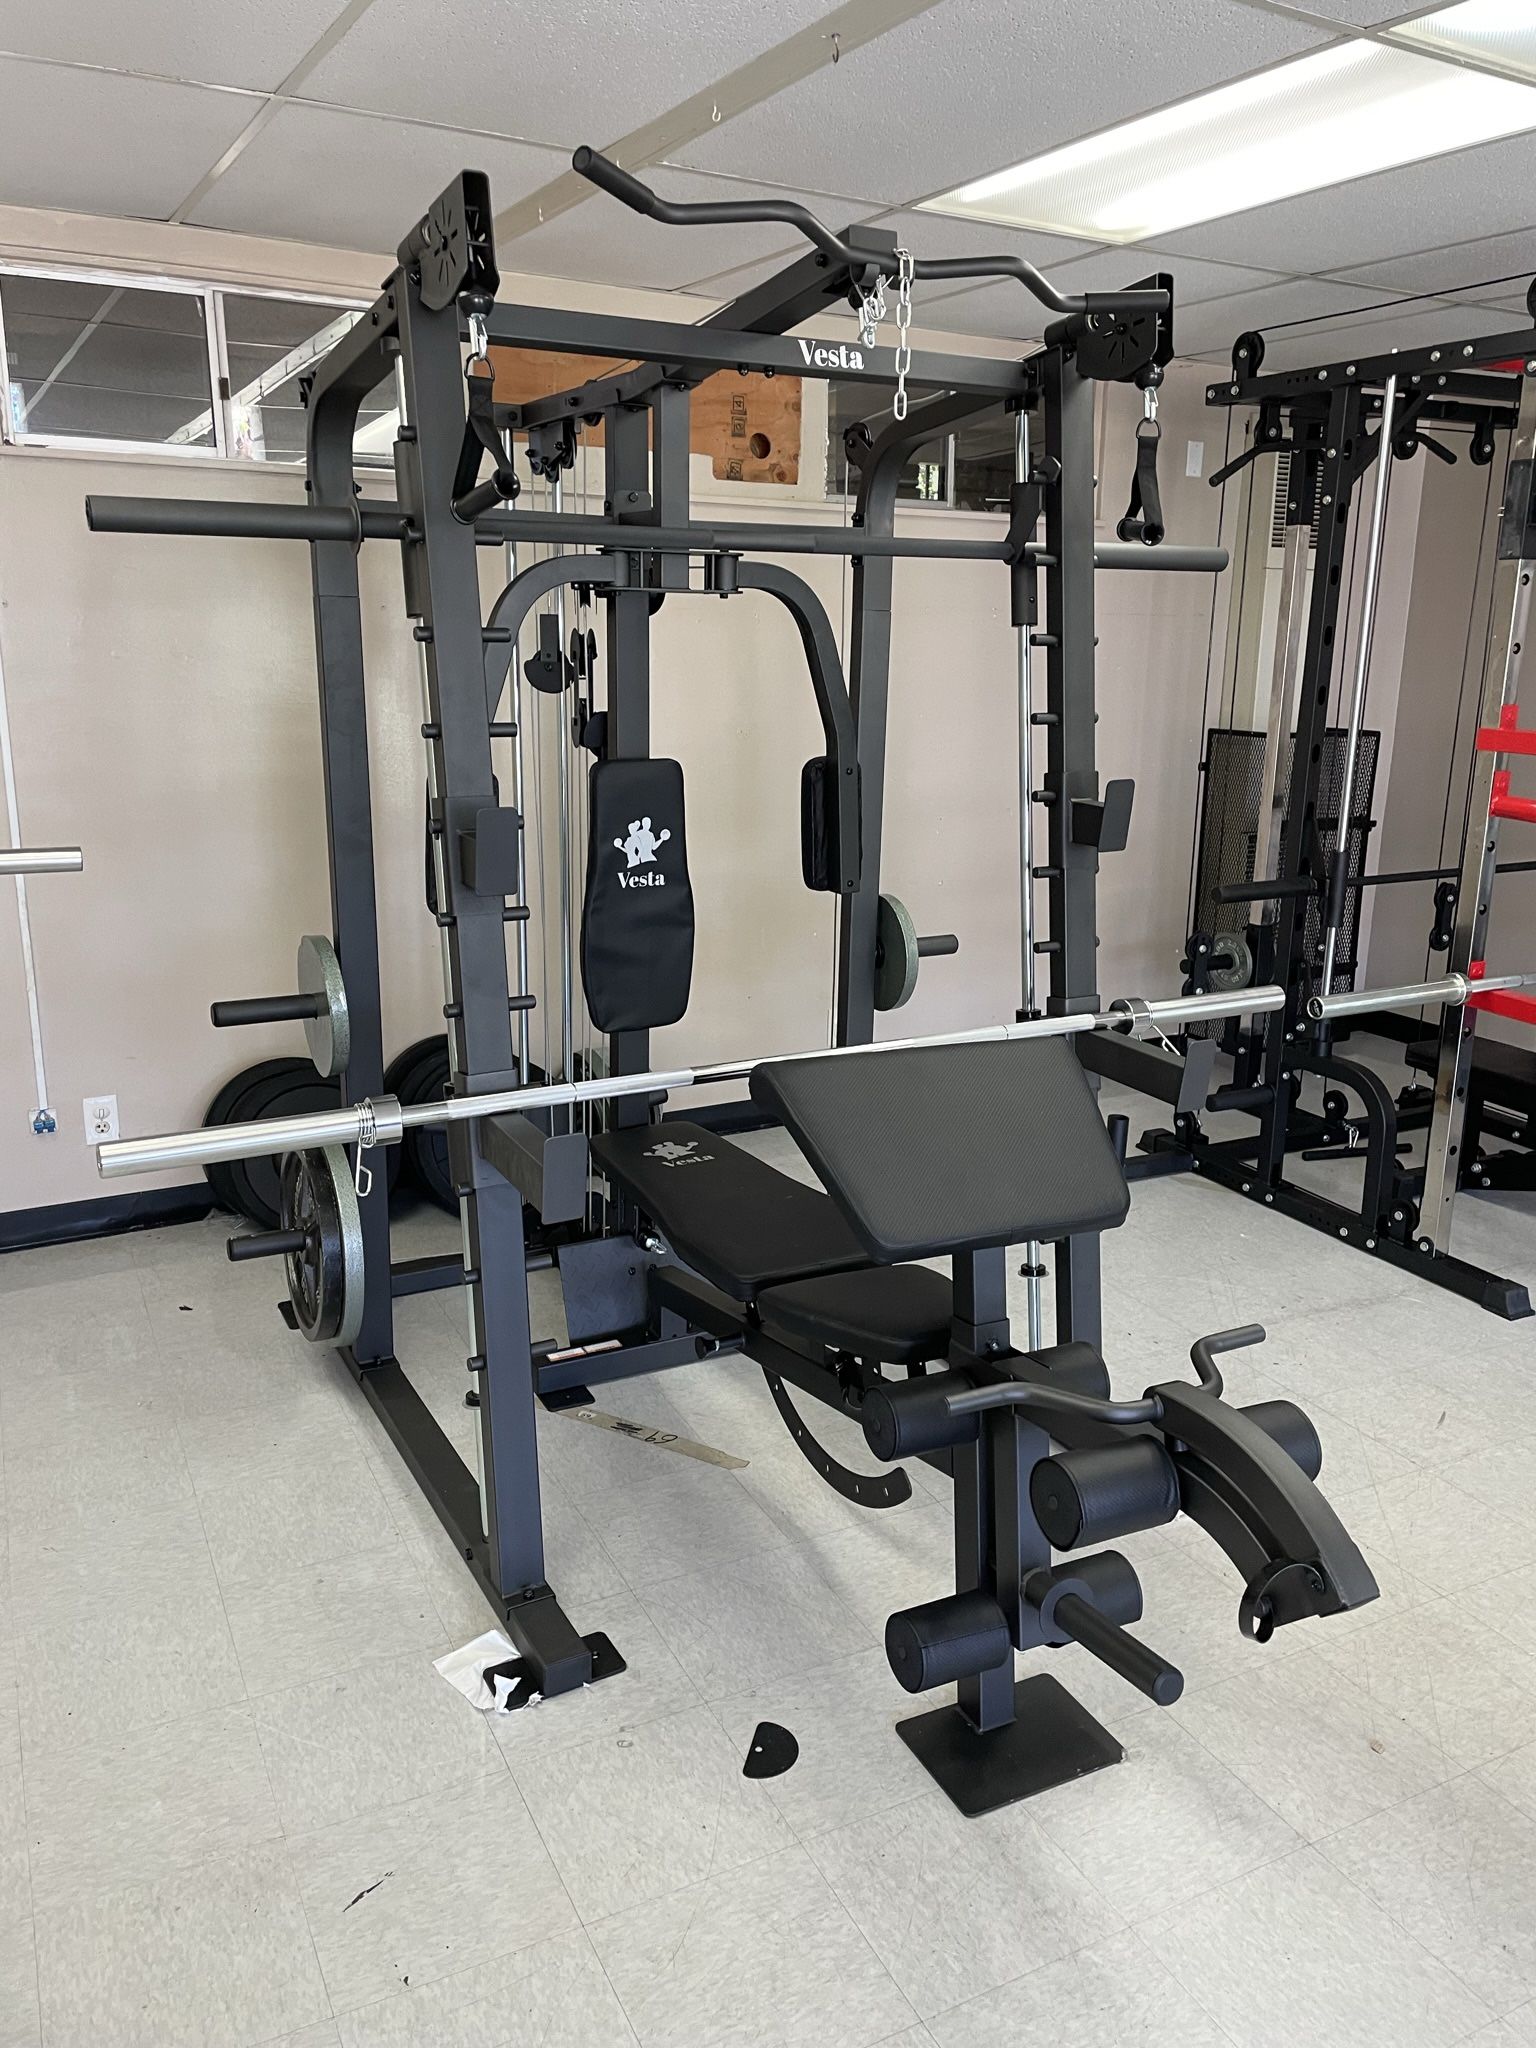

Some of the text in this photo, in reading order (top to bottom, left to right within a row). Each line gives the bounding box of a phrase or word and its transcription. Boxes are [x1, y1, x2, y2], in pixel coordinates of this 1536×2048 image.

[797, 339, 865, 370] Vesta
[617, 871, 665, 888] Vesta
[661, 1155, 715, 1167] Vesta
